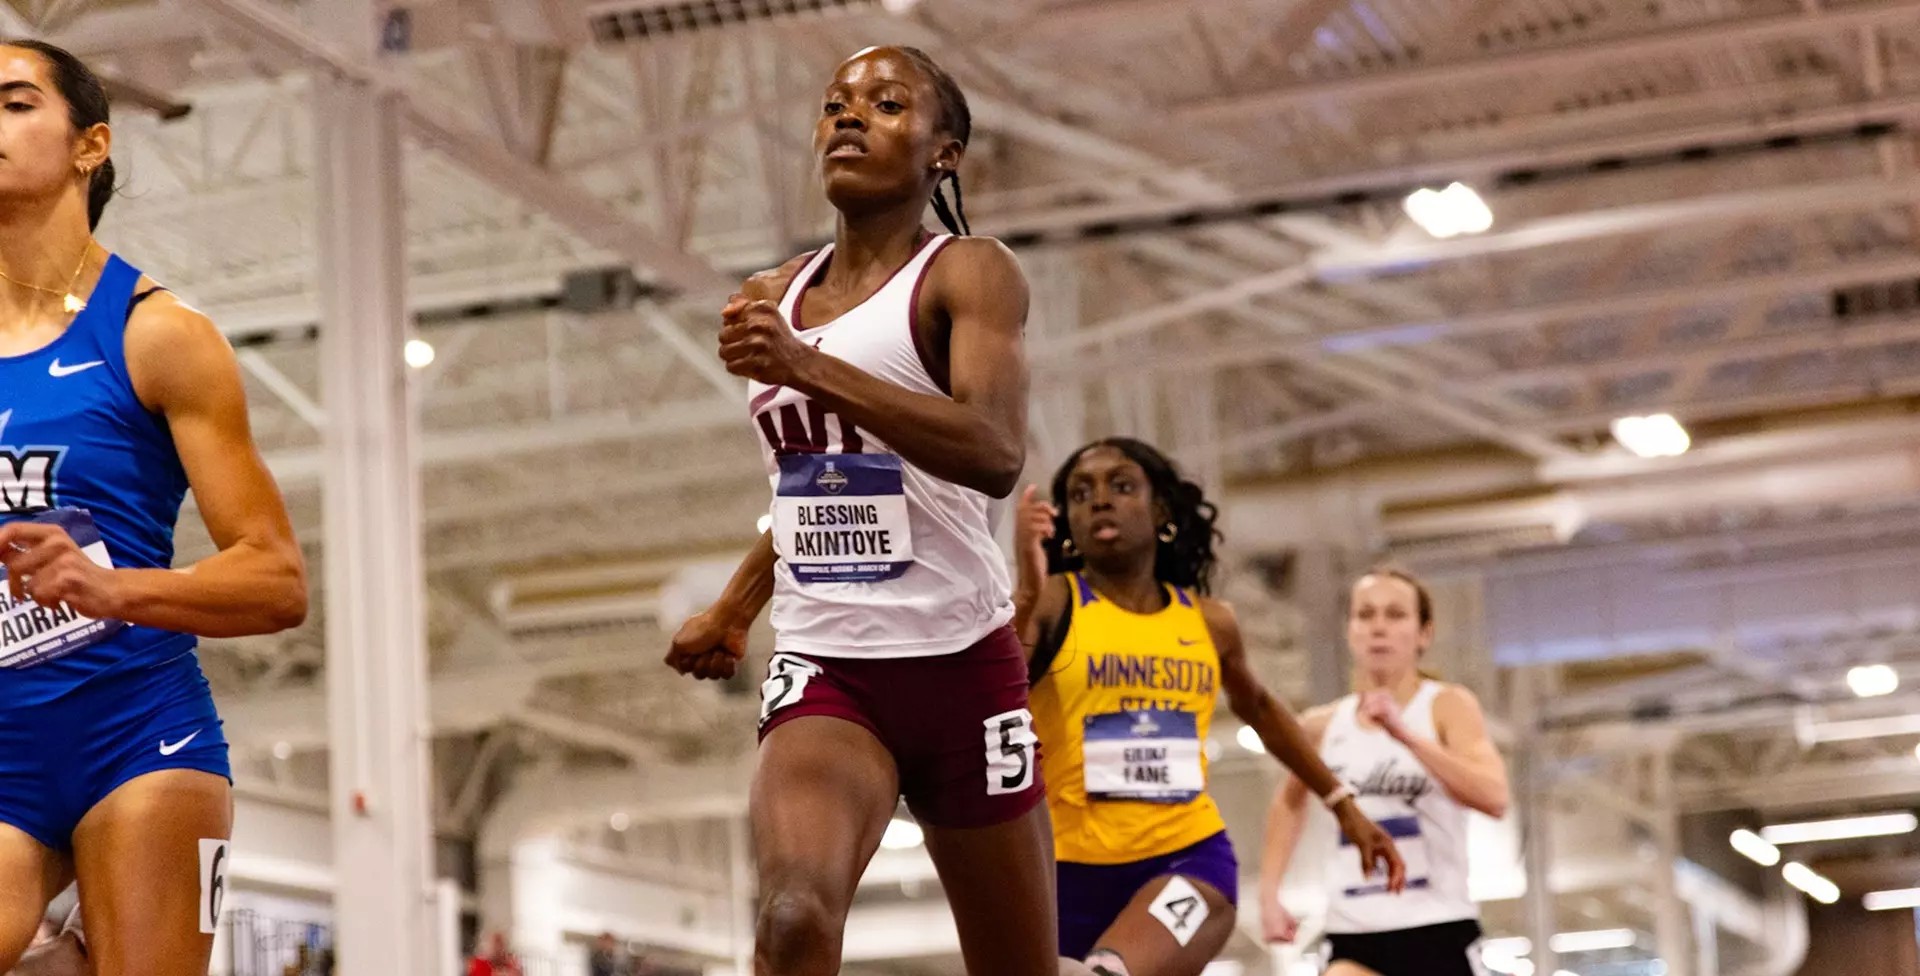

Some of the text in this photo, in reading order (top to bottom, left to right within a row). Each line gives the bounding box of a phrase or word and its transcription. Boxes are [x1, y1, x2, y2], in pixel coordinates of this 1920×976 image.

[797, 504, 878, 526] BLESSING
[794, 530, 892, 557] AKINTOYE
[1087, 653, 1214, 695] MINNESOTA
[999, 715, 1028, 789] 5
[210, 844, 226, 929] 6
[1164, 896, 1199, 929] 4
